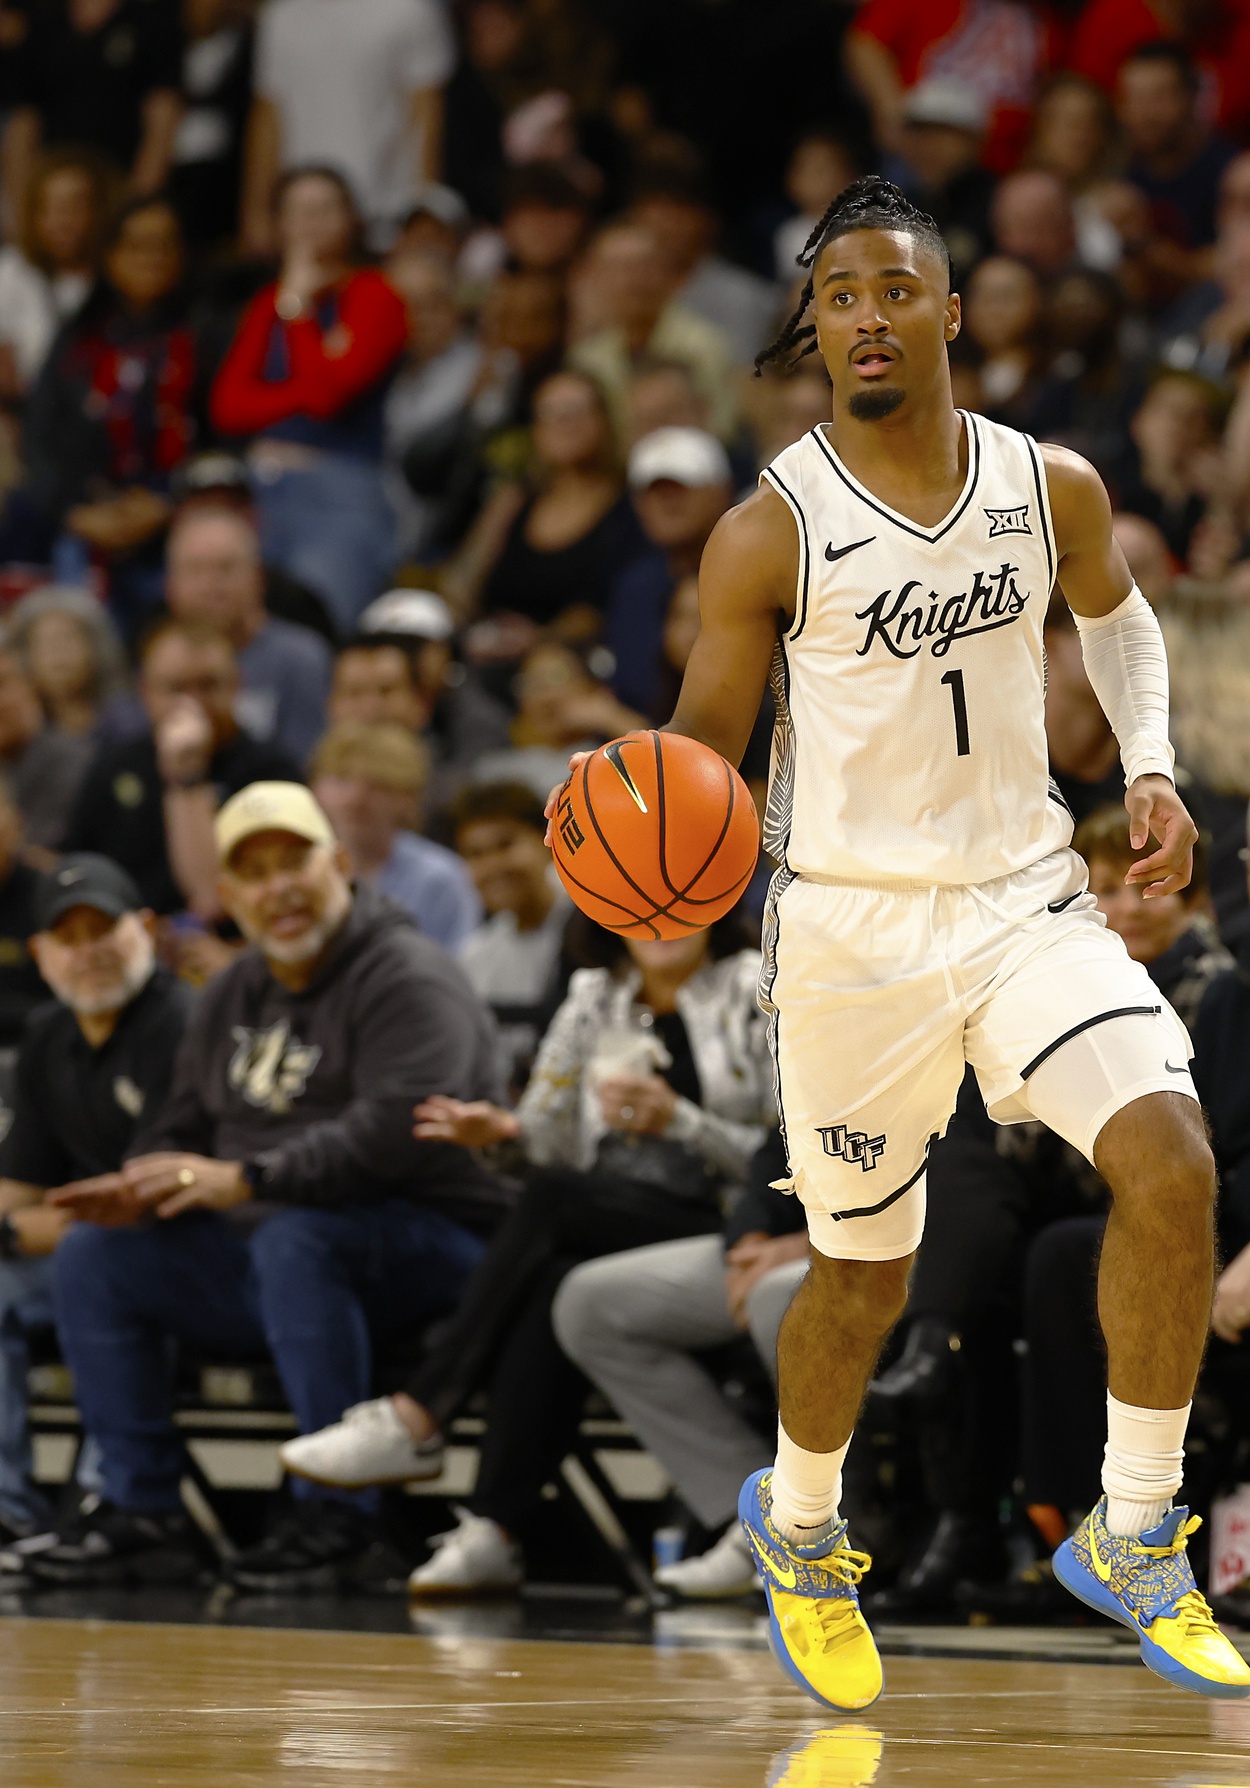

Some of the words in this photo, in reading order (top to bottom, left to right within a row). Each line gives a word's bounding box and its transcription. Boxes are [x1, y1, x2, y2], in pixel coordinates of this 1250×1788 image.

[855, 563, 1031, 659] Knights
[941, 669, 971, 756] 1
[814, 1124, 887, 1173] UCF
